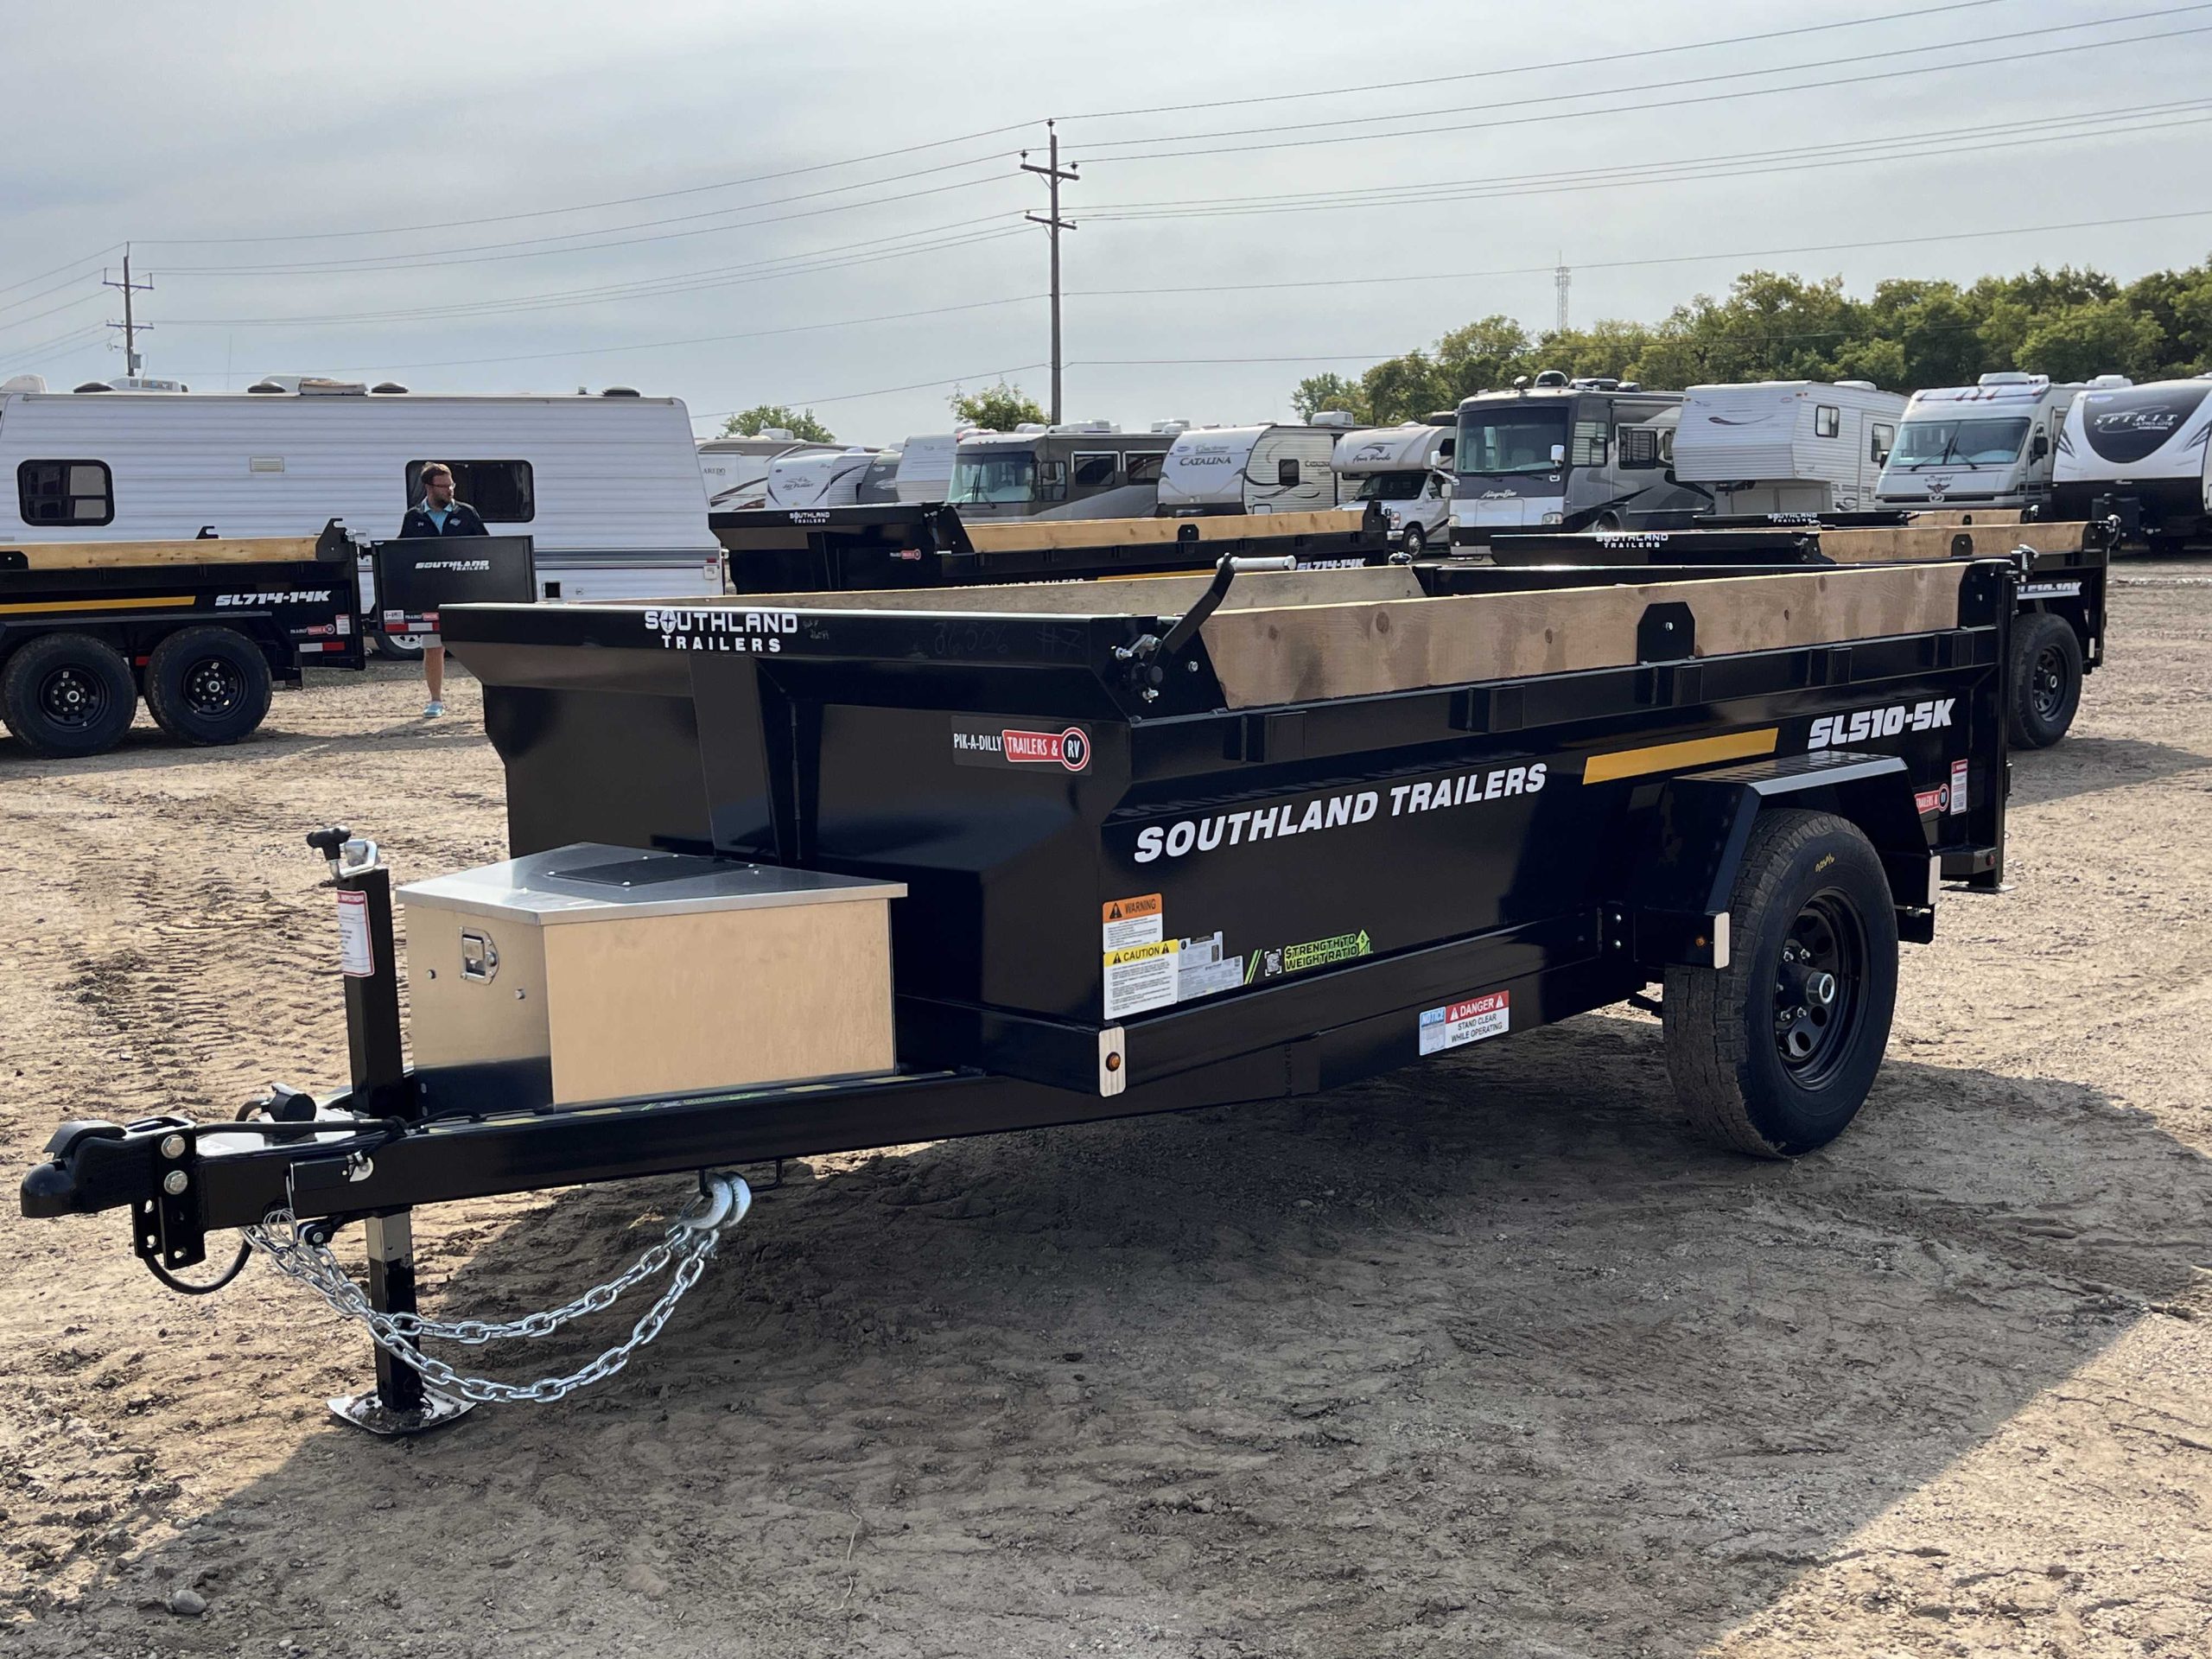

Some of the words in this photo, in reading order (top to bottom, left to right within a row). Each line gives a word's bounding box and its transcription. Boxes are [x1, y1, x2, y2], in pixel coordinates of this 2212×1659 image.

[2094, 415, 2177, 425] SPIRIT
[1179, 456, 1232, 467] CATALINA
[702, 467, 726, 476] AREDO
[415, 560, 490, 569] SOUTHLAND
[1297, 557, 1366, 571] SL714-14K
[215, 590, 332, 607] SL714-14K
[645, 609, 798, 635] SOUTHLAND
[661, 635, 781, 652] TRAILERS
[1808, 698, 1956, 750] SL510-5K
[953, 733, 1002, 753] PIK-A-DILLY
[1007, 736, 1048, 756] TRAILERS
[1051, 740, 1058, 757] &
[1067, 740, 1081, 759] RV
[1134, 791, 1379, 863] SOUTHLAND
[1389, 762, 1548, 817] TRAILERS
[1125, 899, 1157, 915] WARNING
[1343, 935, 1357, 948] TO
[1123, 946, 1160, 962] CAUTION
[1286, 953, 1326, 970] WEIGHT
[1326, 946, 1358, 962] RATIO
[1460, 998, 1494, 1017] DANGER
[1421, 1009, 1445, 1025] NOTICE
[1458, 1017, 1477, 1031] STAND
[1478, 1013, 1497, 1026] CLEAR
[1452, 1032, 1470, 1043] WHILE
[1471, 1022, 1503, 1037] OPERATING
